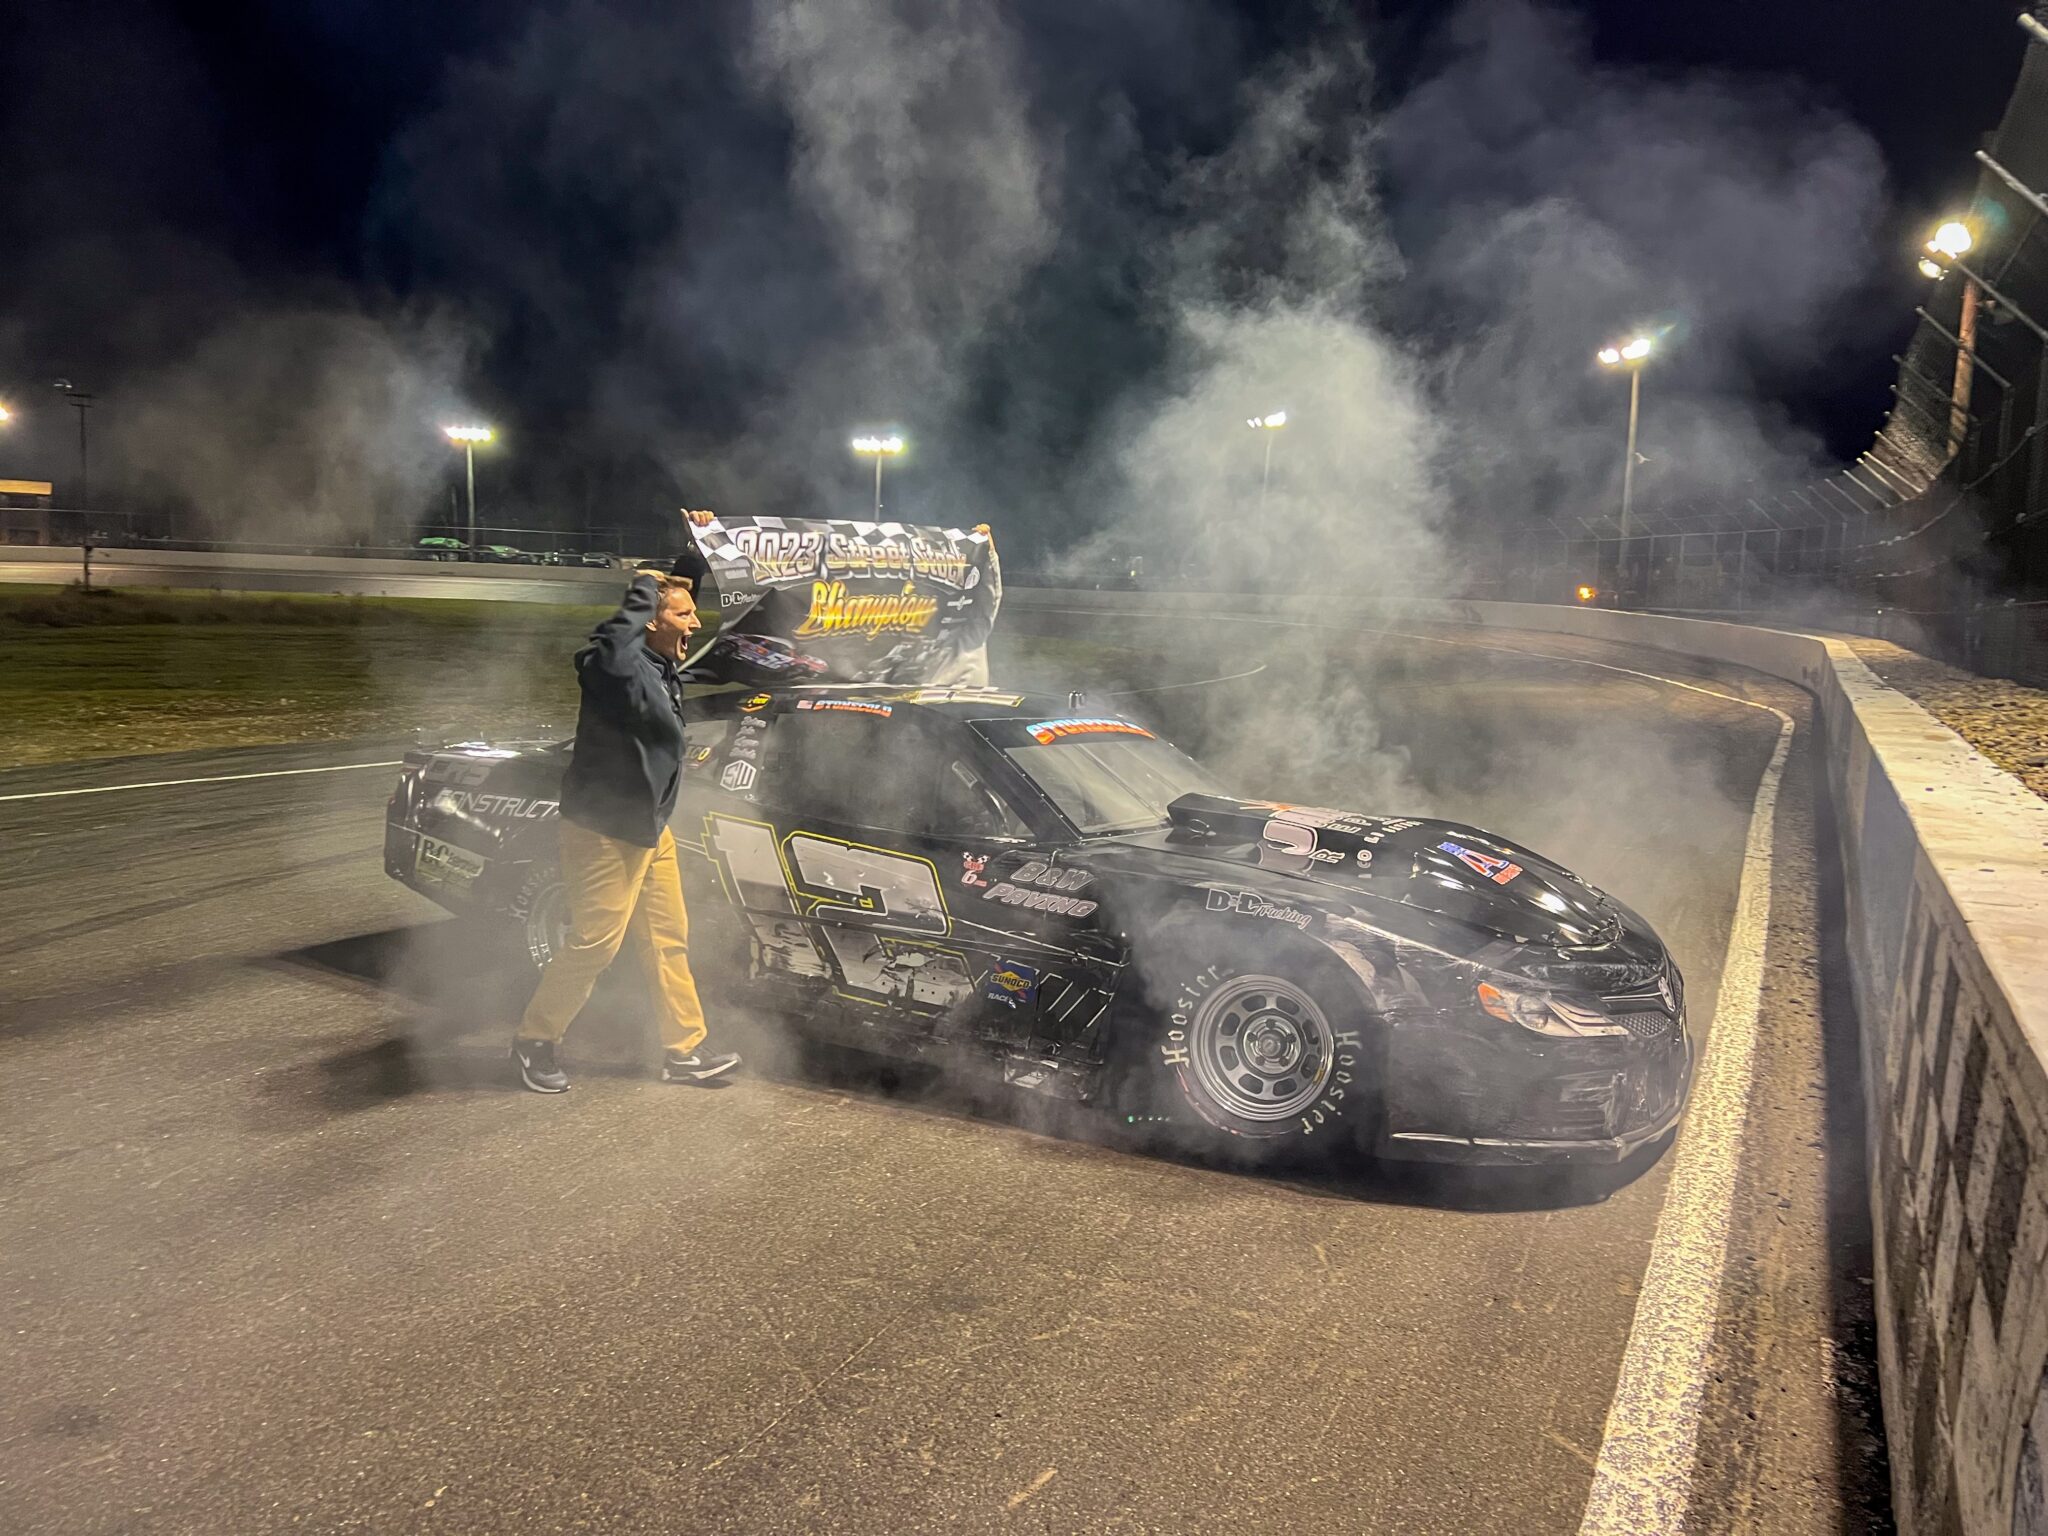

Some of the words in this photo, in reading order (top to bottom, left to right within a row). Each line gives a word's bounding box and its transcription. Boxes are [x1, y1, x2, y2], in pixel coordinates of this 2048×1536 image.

[736, 530, 819, 583] 2023
[825, 533, 911, 574] Street
[1010, 861, 1096, 890] B&W
[982, 882, 1100, 917] PAVING
[991, 973, 1031, 989] SUNOCO
[1161, 965, 1219, 1069] Hoosier
[1301, 1030, 1363, 1135] Hoosier
